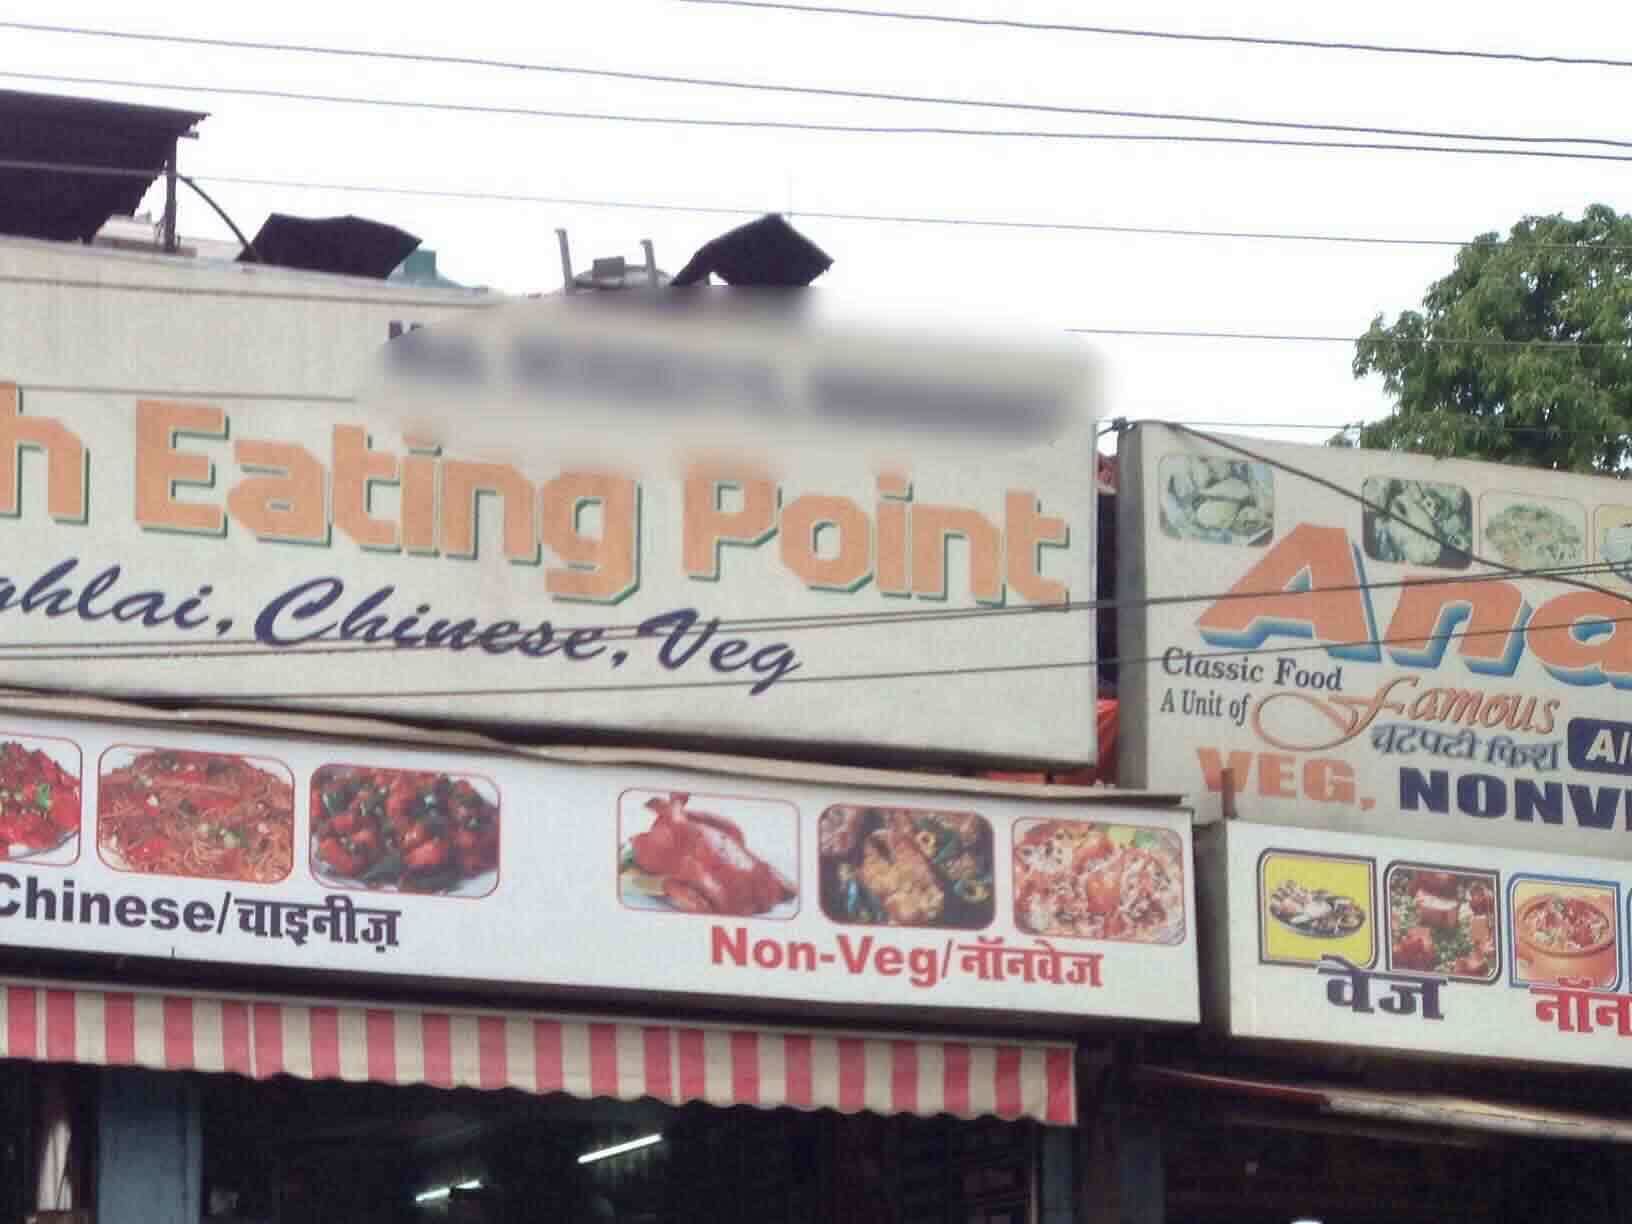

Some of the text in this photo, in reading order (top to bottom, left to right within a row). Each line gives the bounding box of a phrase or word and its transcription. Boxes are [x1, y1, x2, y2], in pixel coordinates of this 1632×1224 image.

[135, 398, 641, 606] Eating
[682, 453, 1070, 611] Point
[254, 576, 627, 667] Chinese,
[637, 606, 802, 697] Veg
[1161, 646, 1344, 692] Classic Food
[1160, 686, 1253, 728] A Unit of
[1197, 746, 1377, 812] VEG,
[1317, 953, 1449, 1021] वेज
